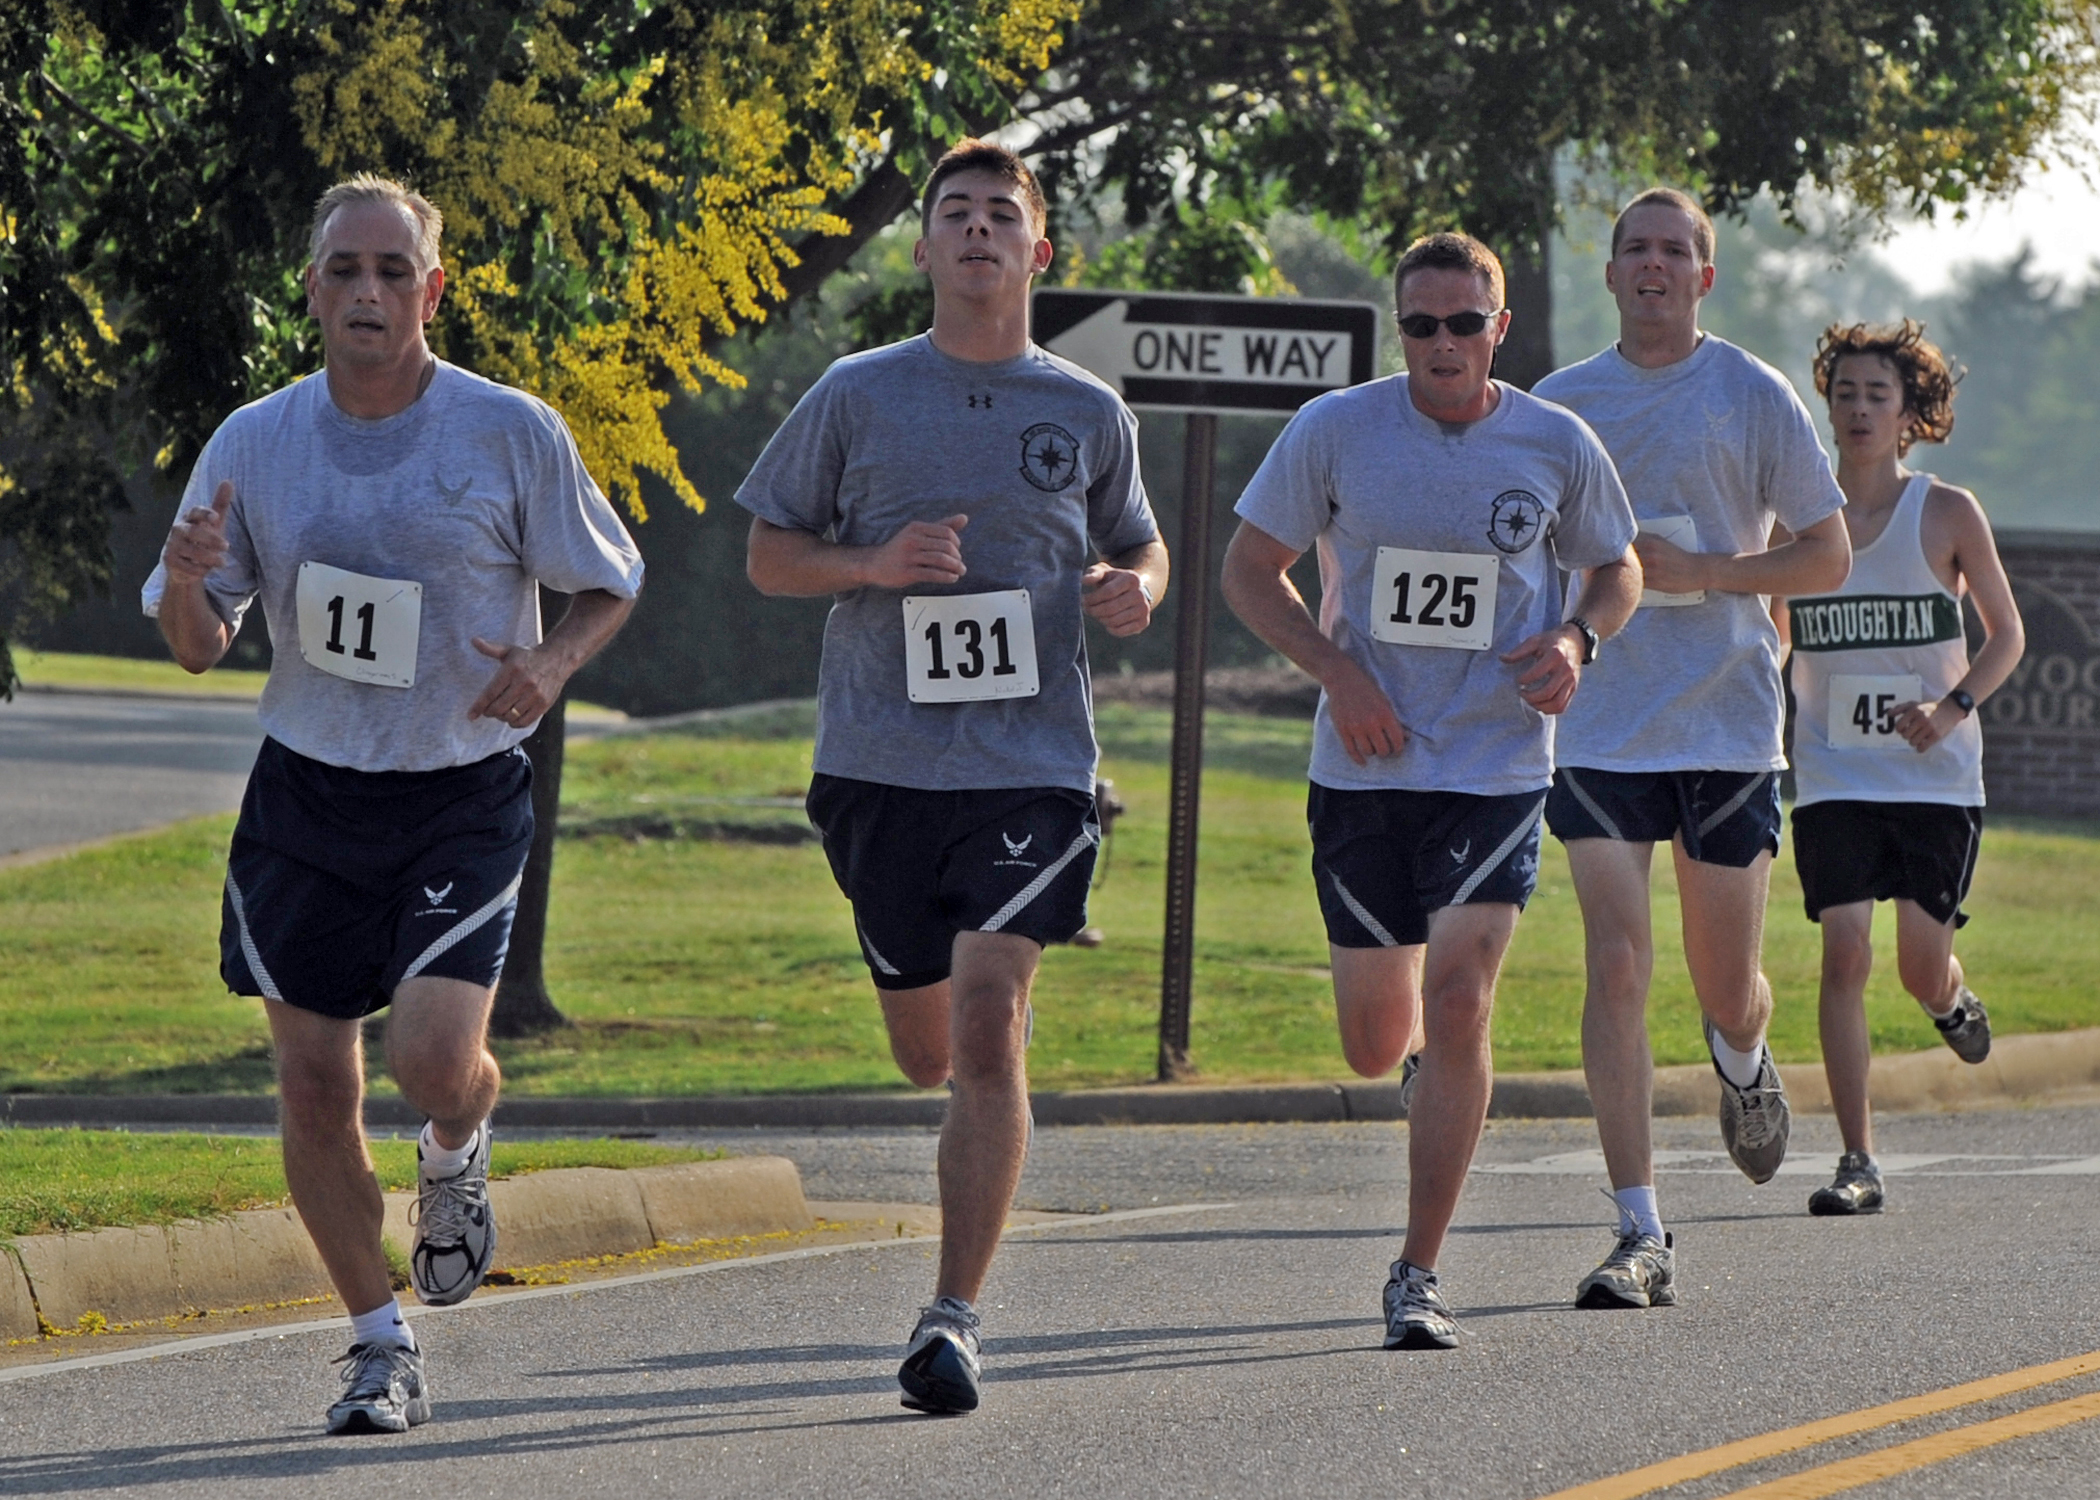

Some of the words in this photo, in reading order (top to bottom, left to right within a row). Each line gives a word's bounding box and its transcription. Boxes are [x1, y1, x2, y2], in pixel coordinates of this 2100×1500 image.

[1133, 329, 1222, 374] ONE
[1243, 334, 1336, 379] WAY
[326, 594, 376, 661] 11
[1390, 571, 1479, 628] 125
[925, 616, 1017, 680] 131
[1852, 693, 1897, 735] 45
